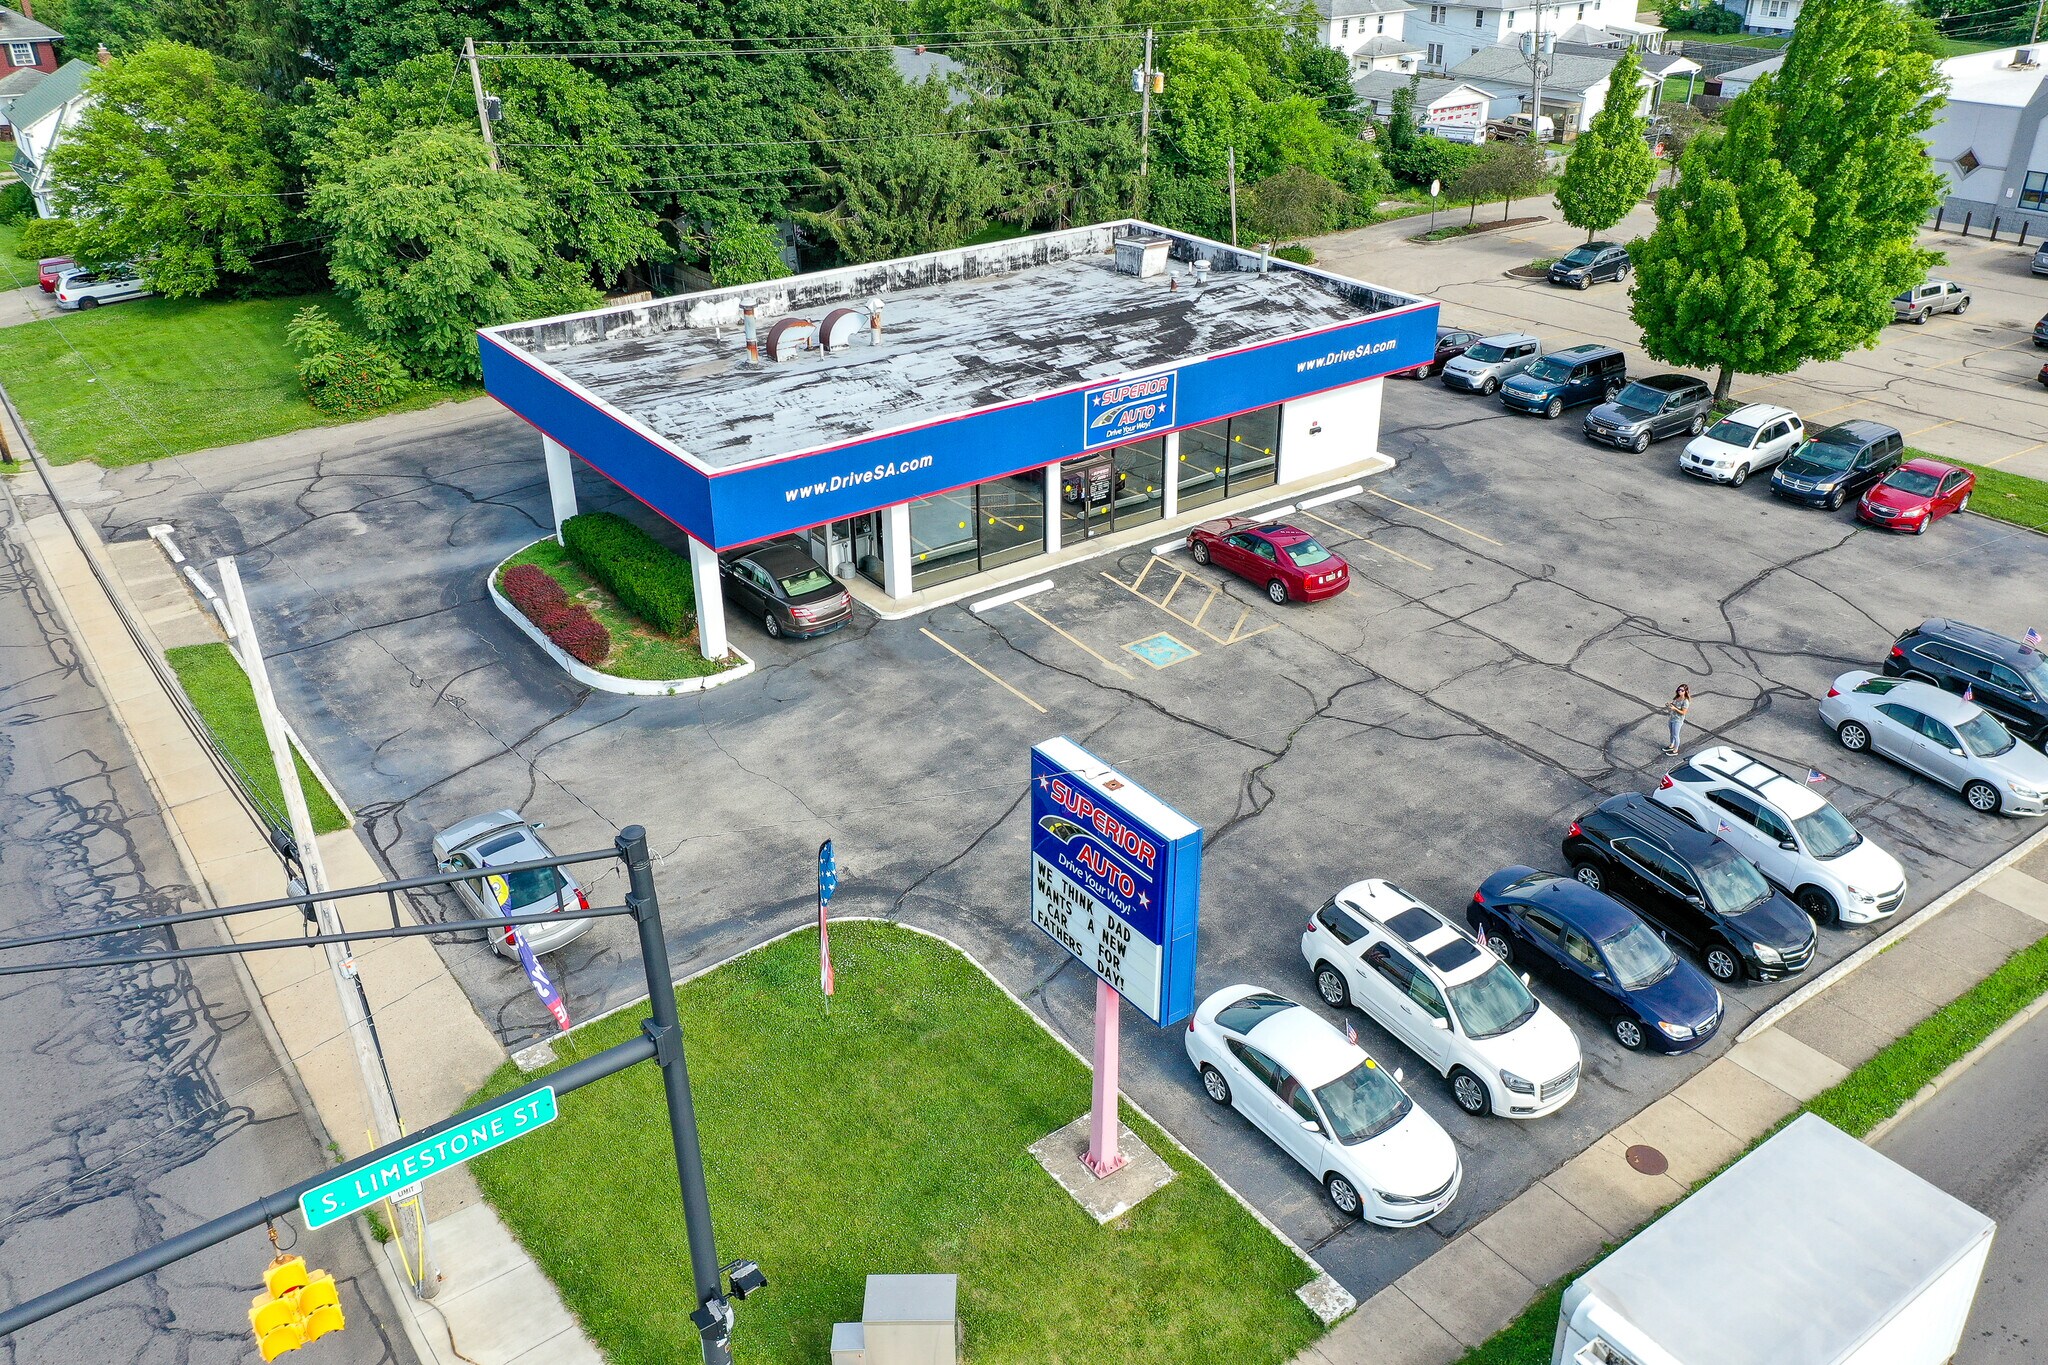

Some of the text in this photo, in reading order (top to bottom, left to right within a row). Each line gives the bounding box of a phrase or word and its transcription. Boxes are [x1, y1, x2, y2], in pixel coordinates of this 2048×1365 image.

[1296, 338, 1397, 373] www.DriveSA.com
[1101, 376, 1169, 407] SUPERIOR
[1118, 404, 1156, 427] AUTO
[1106, 419, 1152, 438] Drive Your Way!
[784, 454, 934, 503] www.DriveSA.com
[1050, 778, 1157, 871] SUPERIOR
[1058, 852, 1131, 916] Drive Your Way!
[1077, 843, 1136, 899] AUTO
[1037, 860, 1131, 943] WE THINK DAD
[1037, 876, 1127, 958] WANTS A NEW
[1037, 909, 1125, 991] FATHERS DAY!
[1047, 903, 1120, 972] CAR FOR
[321, 1100, 541, 1215] S. LIMESTONE ST
[397, 1185, 414, 1198] LIMIT
